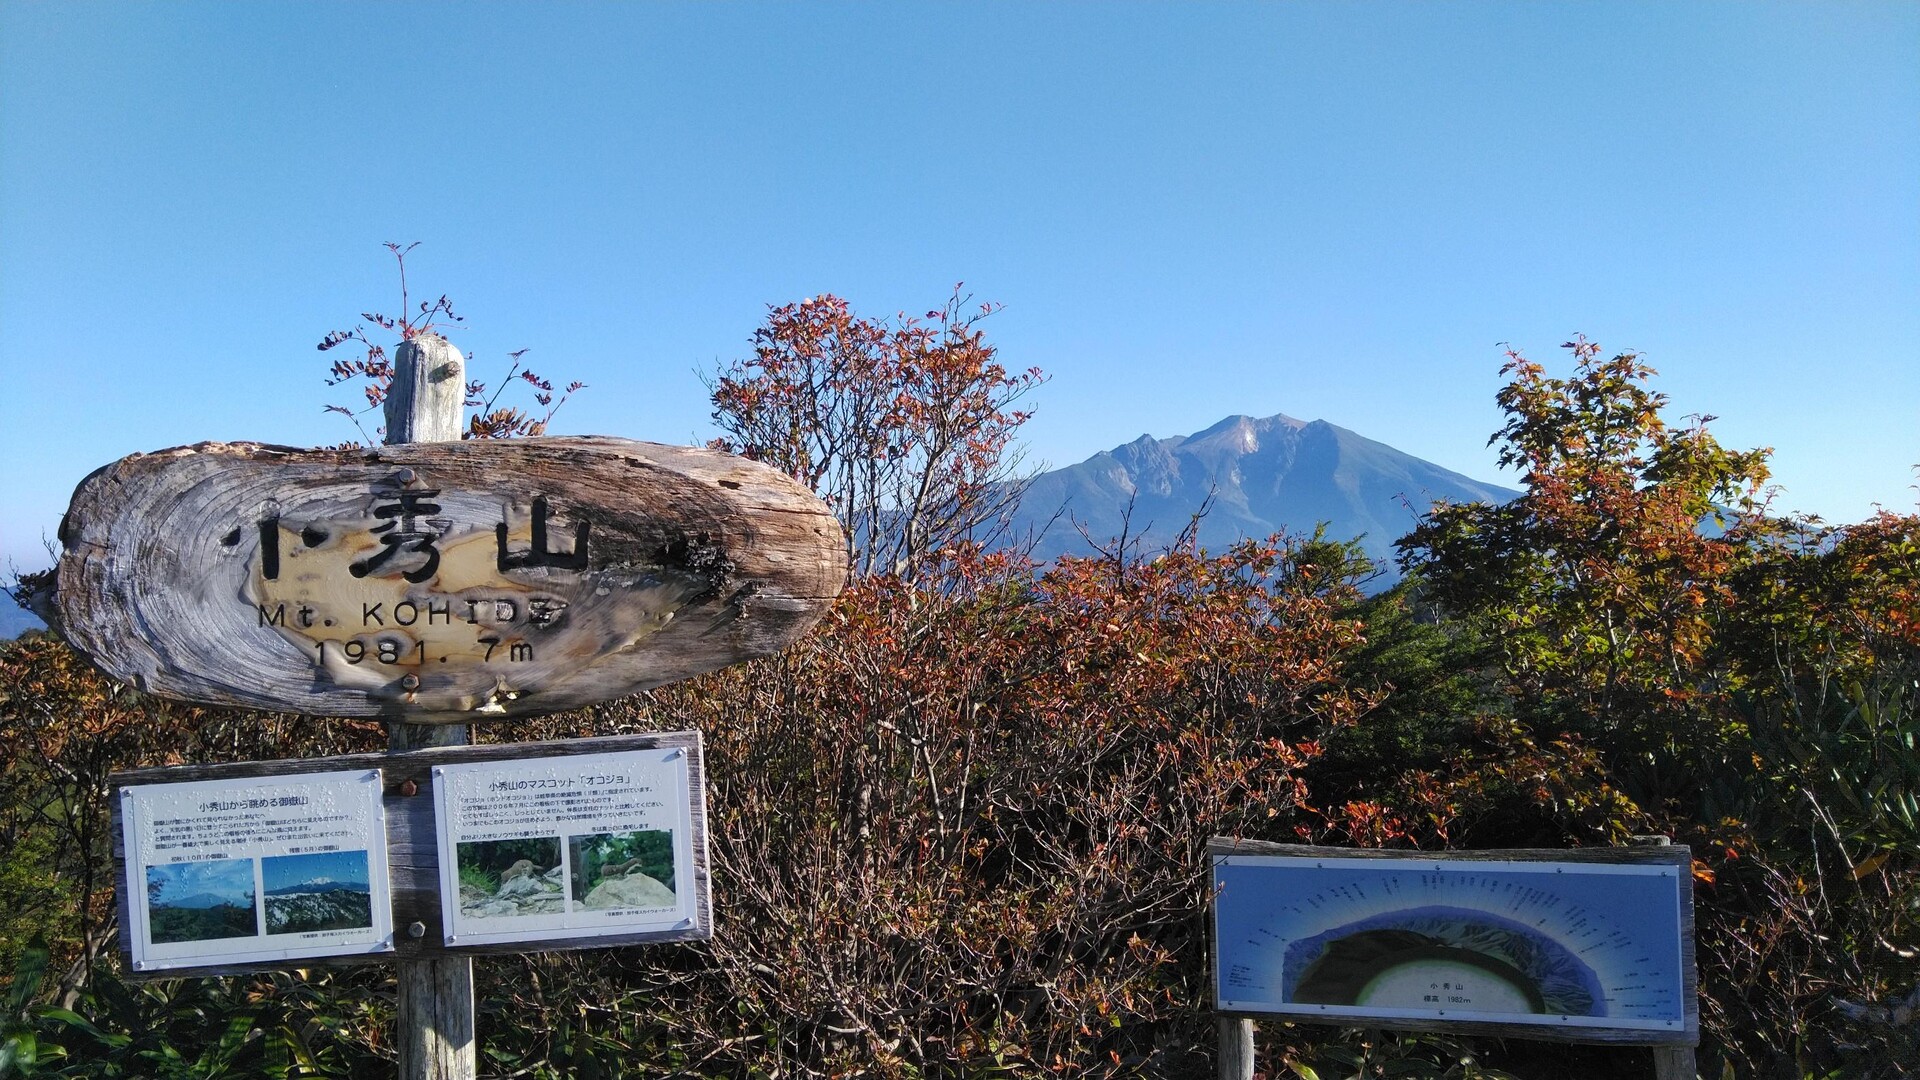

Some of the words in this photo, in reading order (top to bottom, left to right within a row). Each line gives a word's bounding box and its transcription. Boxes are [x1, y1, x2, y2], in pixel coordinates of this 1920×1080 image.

[220, 488, 592, 584] 小秀山
[258, 602, 334, 628] Mt.
[362, 600, 557, 626] KOHIDE
[488, 775, 631, 792] 小秀山のマスコット「オコジョ」
[199, 796, 309, 813] 小秀山から眺める御嶽山
